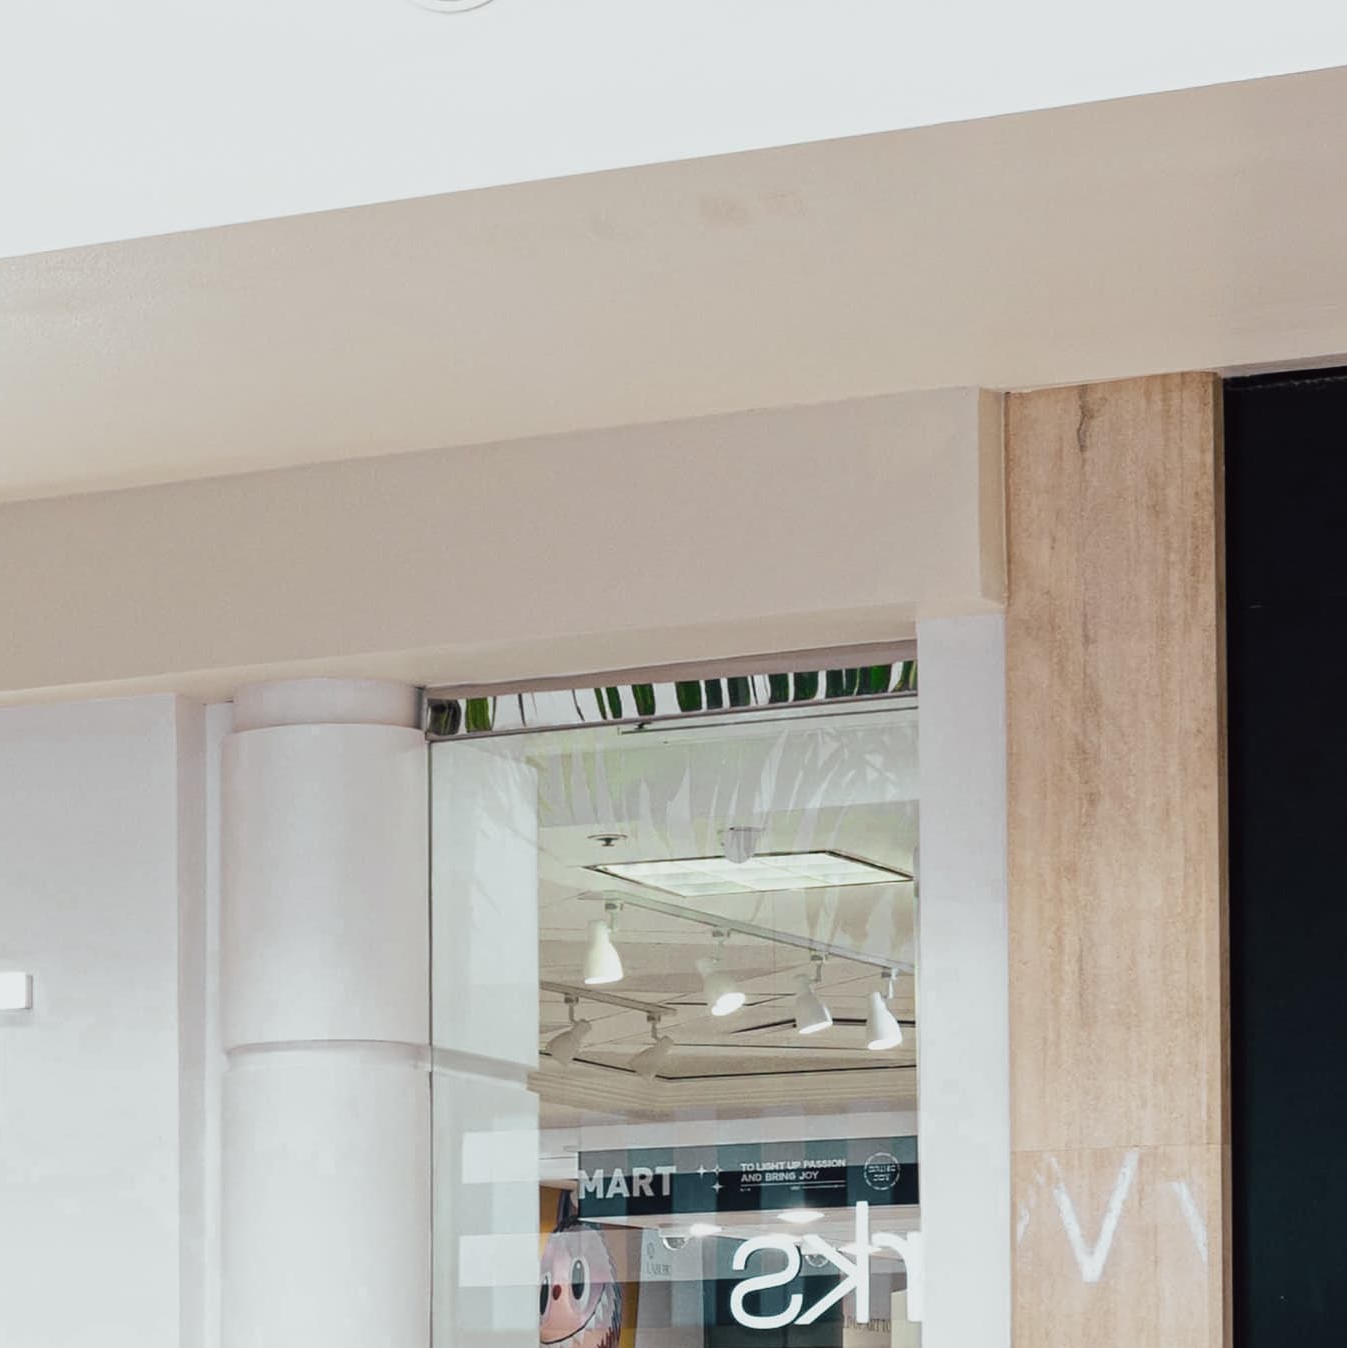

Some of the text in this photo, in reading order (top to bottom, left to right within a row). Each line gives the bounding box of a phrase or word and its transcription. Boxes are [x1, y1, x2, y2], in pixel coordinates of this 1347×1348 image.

[740, 1159, 846, 1172] TO LIGHT UP PASSION
[578, 1166, 677, 1200] MART
[741, 1171, 819, 1182] AND BRING JOY
